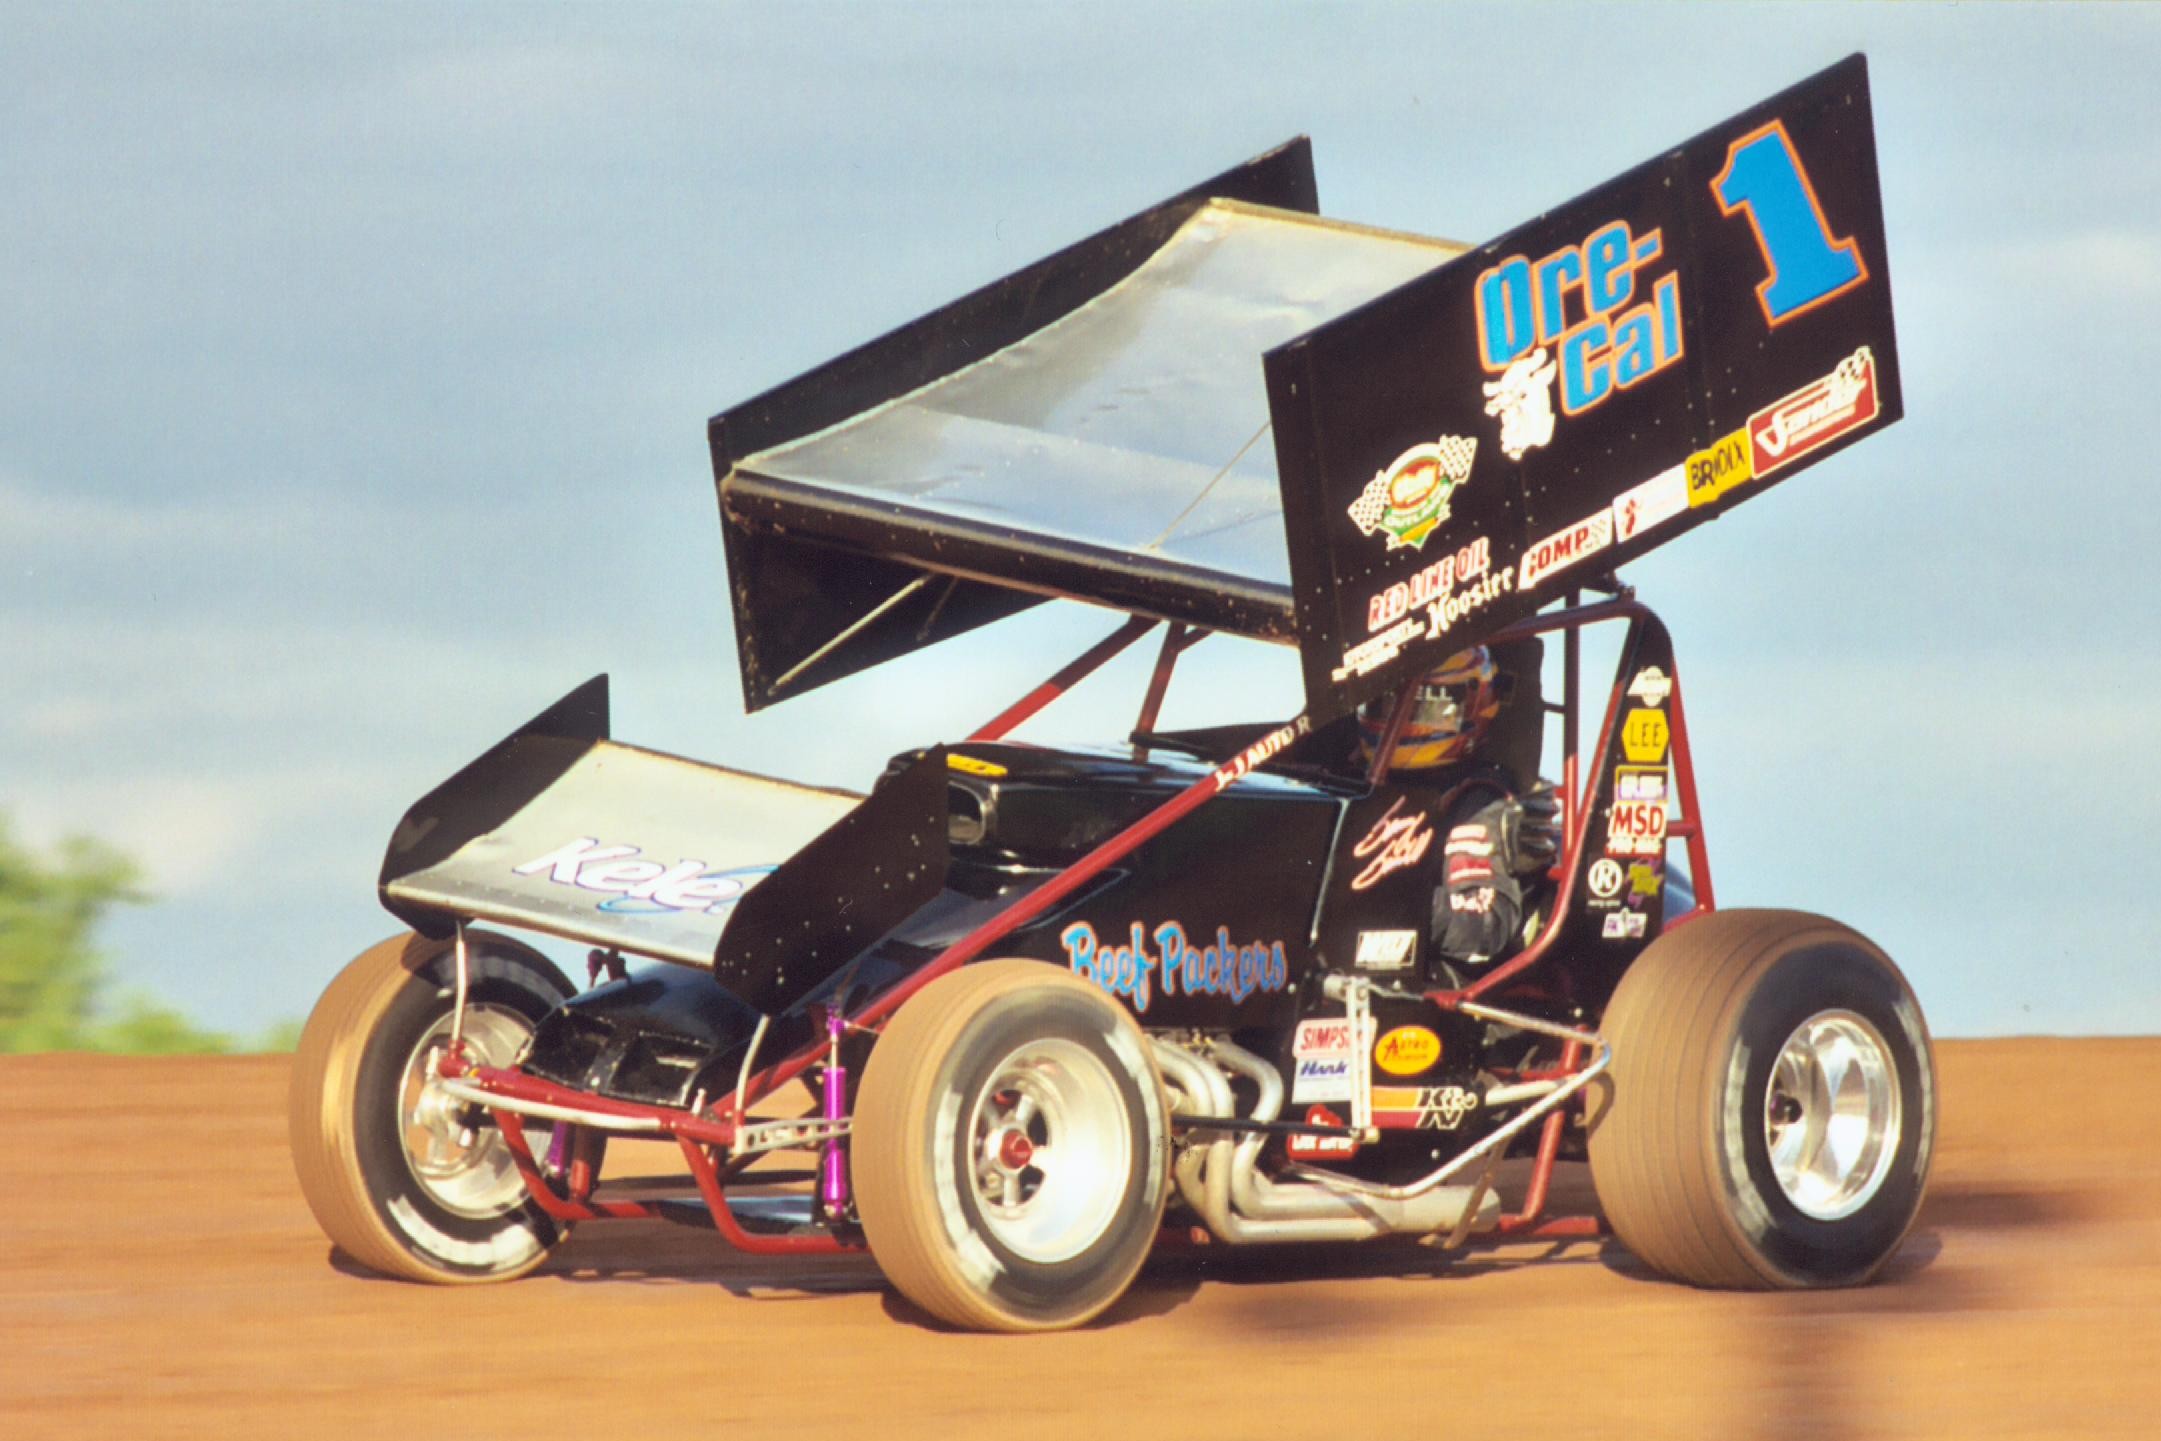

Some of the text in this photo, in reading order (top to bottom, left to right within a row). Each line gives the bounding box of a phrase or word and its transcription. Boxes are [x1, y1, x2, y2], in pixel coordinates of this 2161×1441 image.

[1709, 117, 1870, 328] 1
[1557, 270, 1684, 416] Cal
[1368, 536, 1491, 632] RED LINE OIL
[1424, 566, 1515, 640] Hoosier
[1246, 725, 1295, 773] AUTO
[1296, 715, 1313, 737] R
[1629, 722, 1662, 747] LEE
[1613, 804, 1665, 836] MSD
[1060, 920, 1158, 1012] Beef
[1153, 919, 1287, 1005] Packers
[1299, 1026, 1352, 1051] SIMPS
